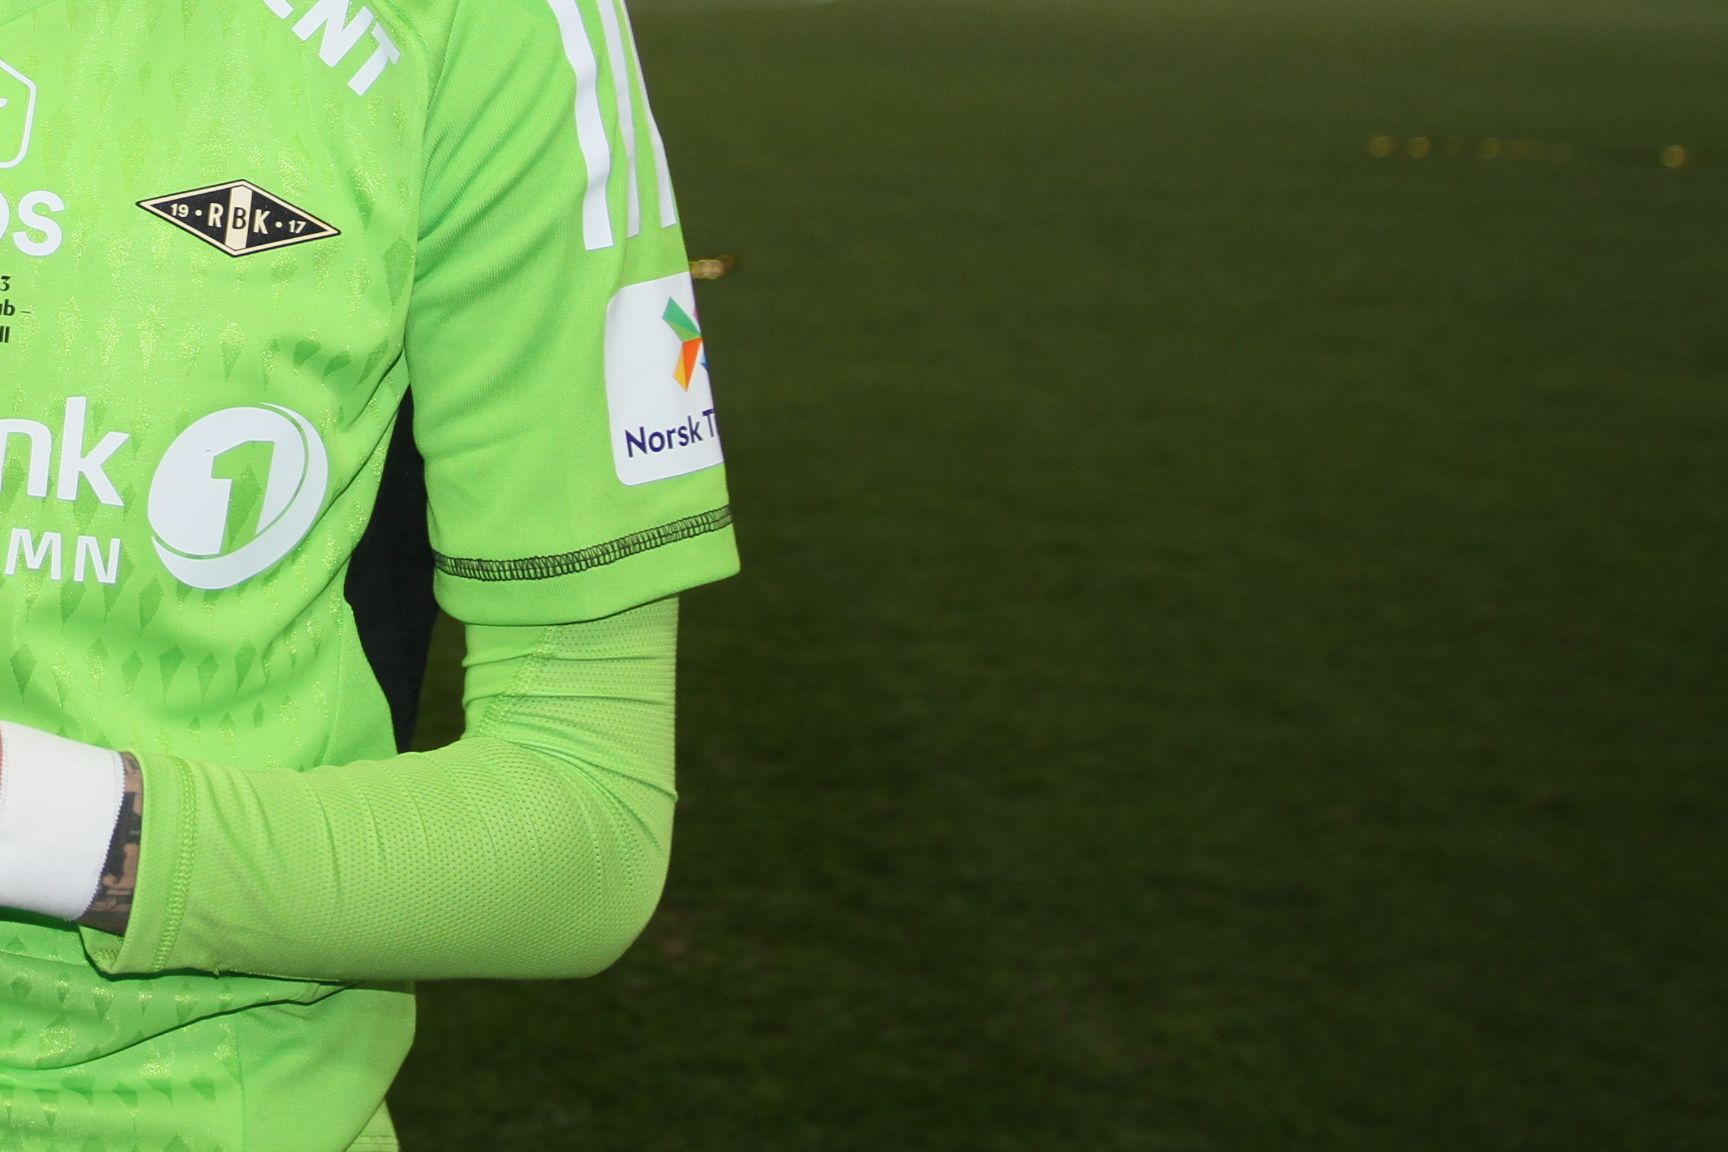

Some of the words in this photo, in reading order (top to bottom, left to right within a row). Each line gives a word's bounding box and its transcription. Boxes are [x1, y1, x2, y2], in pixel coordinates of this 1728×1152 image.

[170, 203, 189, 218] 19
[207, 202, 271, 235] RBK
[288, 219, 307, 234] 17
[625, 415, 703, 458] Norsk
